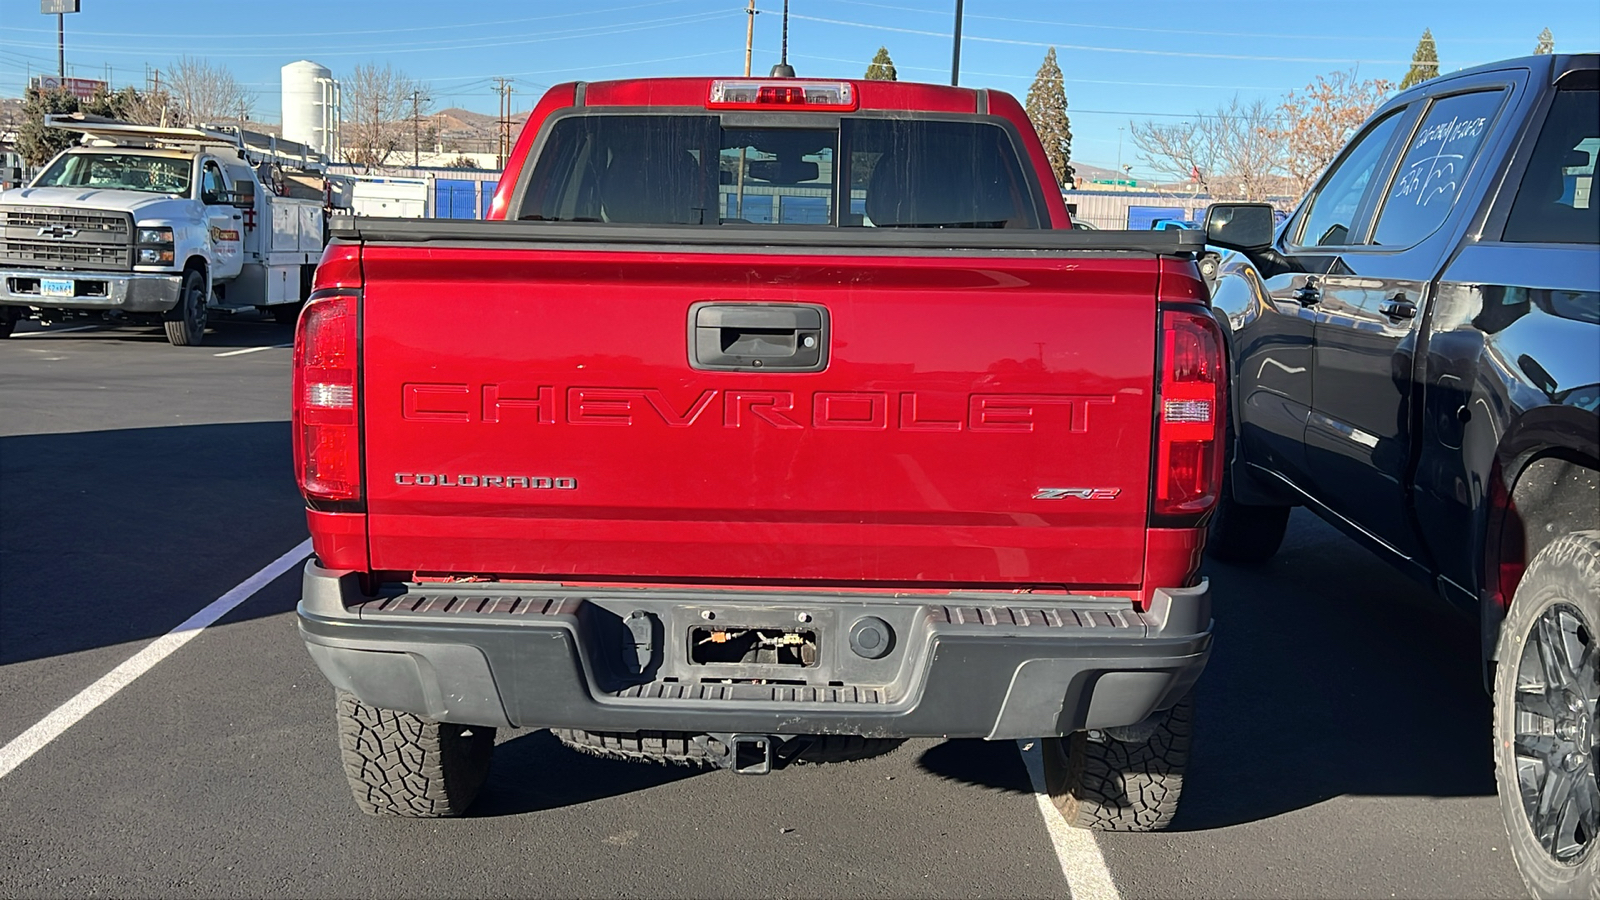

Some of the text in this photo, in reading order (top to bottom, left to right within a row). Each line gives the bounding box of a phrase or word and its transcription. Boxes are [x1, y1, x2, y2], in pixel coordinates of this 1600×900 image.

[401, 382, 1117, 433] CHEVROLET
[394, 472, 578, 490] COLORADO
[1032, 487, 1121, 500] ZR2
